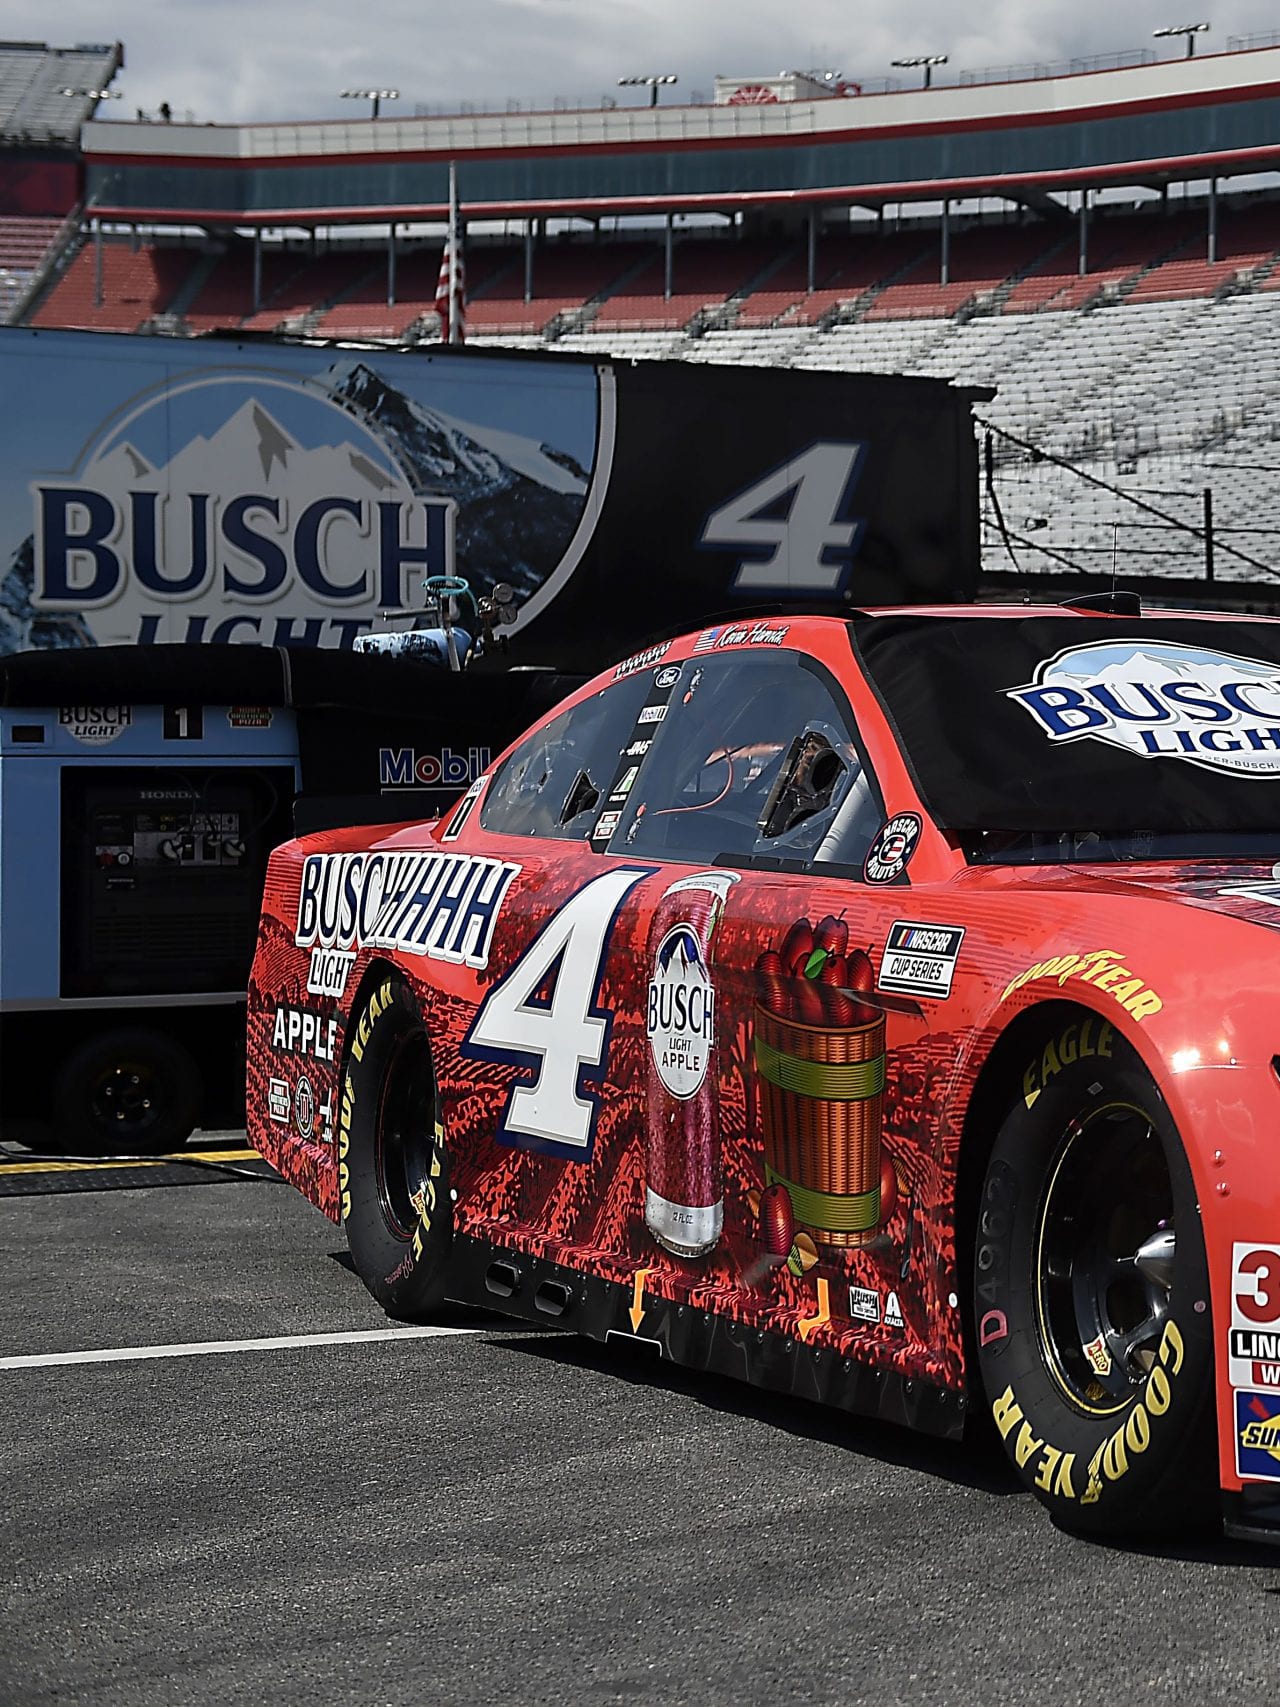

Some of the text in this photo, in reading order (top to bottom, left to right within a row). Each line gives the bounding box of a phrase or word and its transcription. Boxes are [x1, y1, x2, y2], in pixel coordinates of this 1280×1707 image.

[698, 441, 863, 590] 4
[38, 488, 450, 608] BUSCH
[658, 669, 679, 685] Ford
[59, 705, 131, 725] BUSCH
[175, 708, 188, 738] 1
[74, 725, 117, 736] LIGHT
[379, 748, 491, 784] Mobil
[884, 818, 917, 843] NASCAR
[867, 856, 904, 880] SALUTES
[908, 929, 953, 952] NASCAR
[309, 952, 355, 990] LIGHT
[890, 957, 944, 981] CUP SERIES
[466, 867, 655, 1152] 4
[648, 983, 713, 1040] BUSCH
[272, 1008, 338, 1061] APPLE
[669, 1038, 692, 1052] LIGHT
[662, 1051, 700, 1072] APPLE
[1023, 1018, 1113, 1097] EAGLE
[1091, 1346, 1107, 1371] AERO
